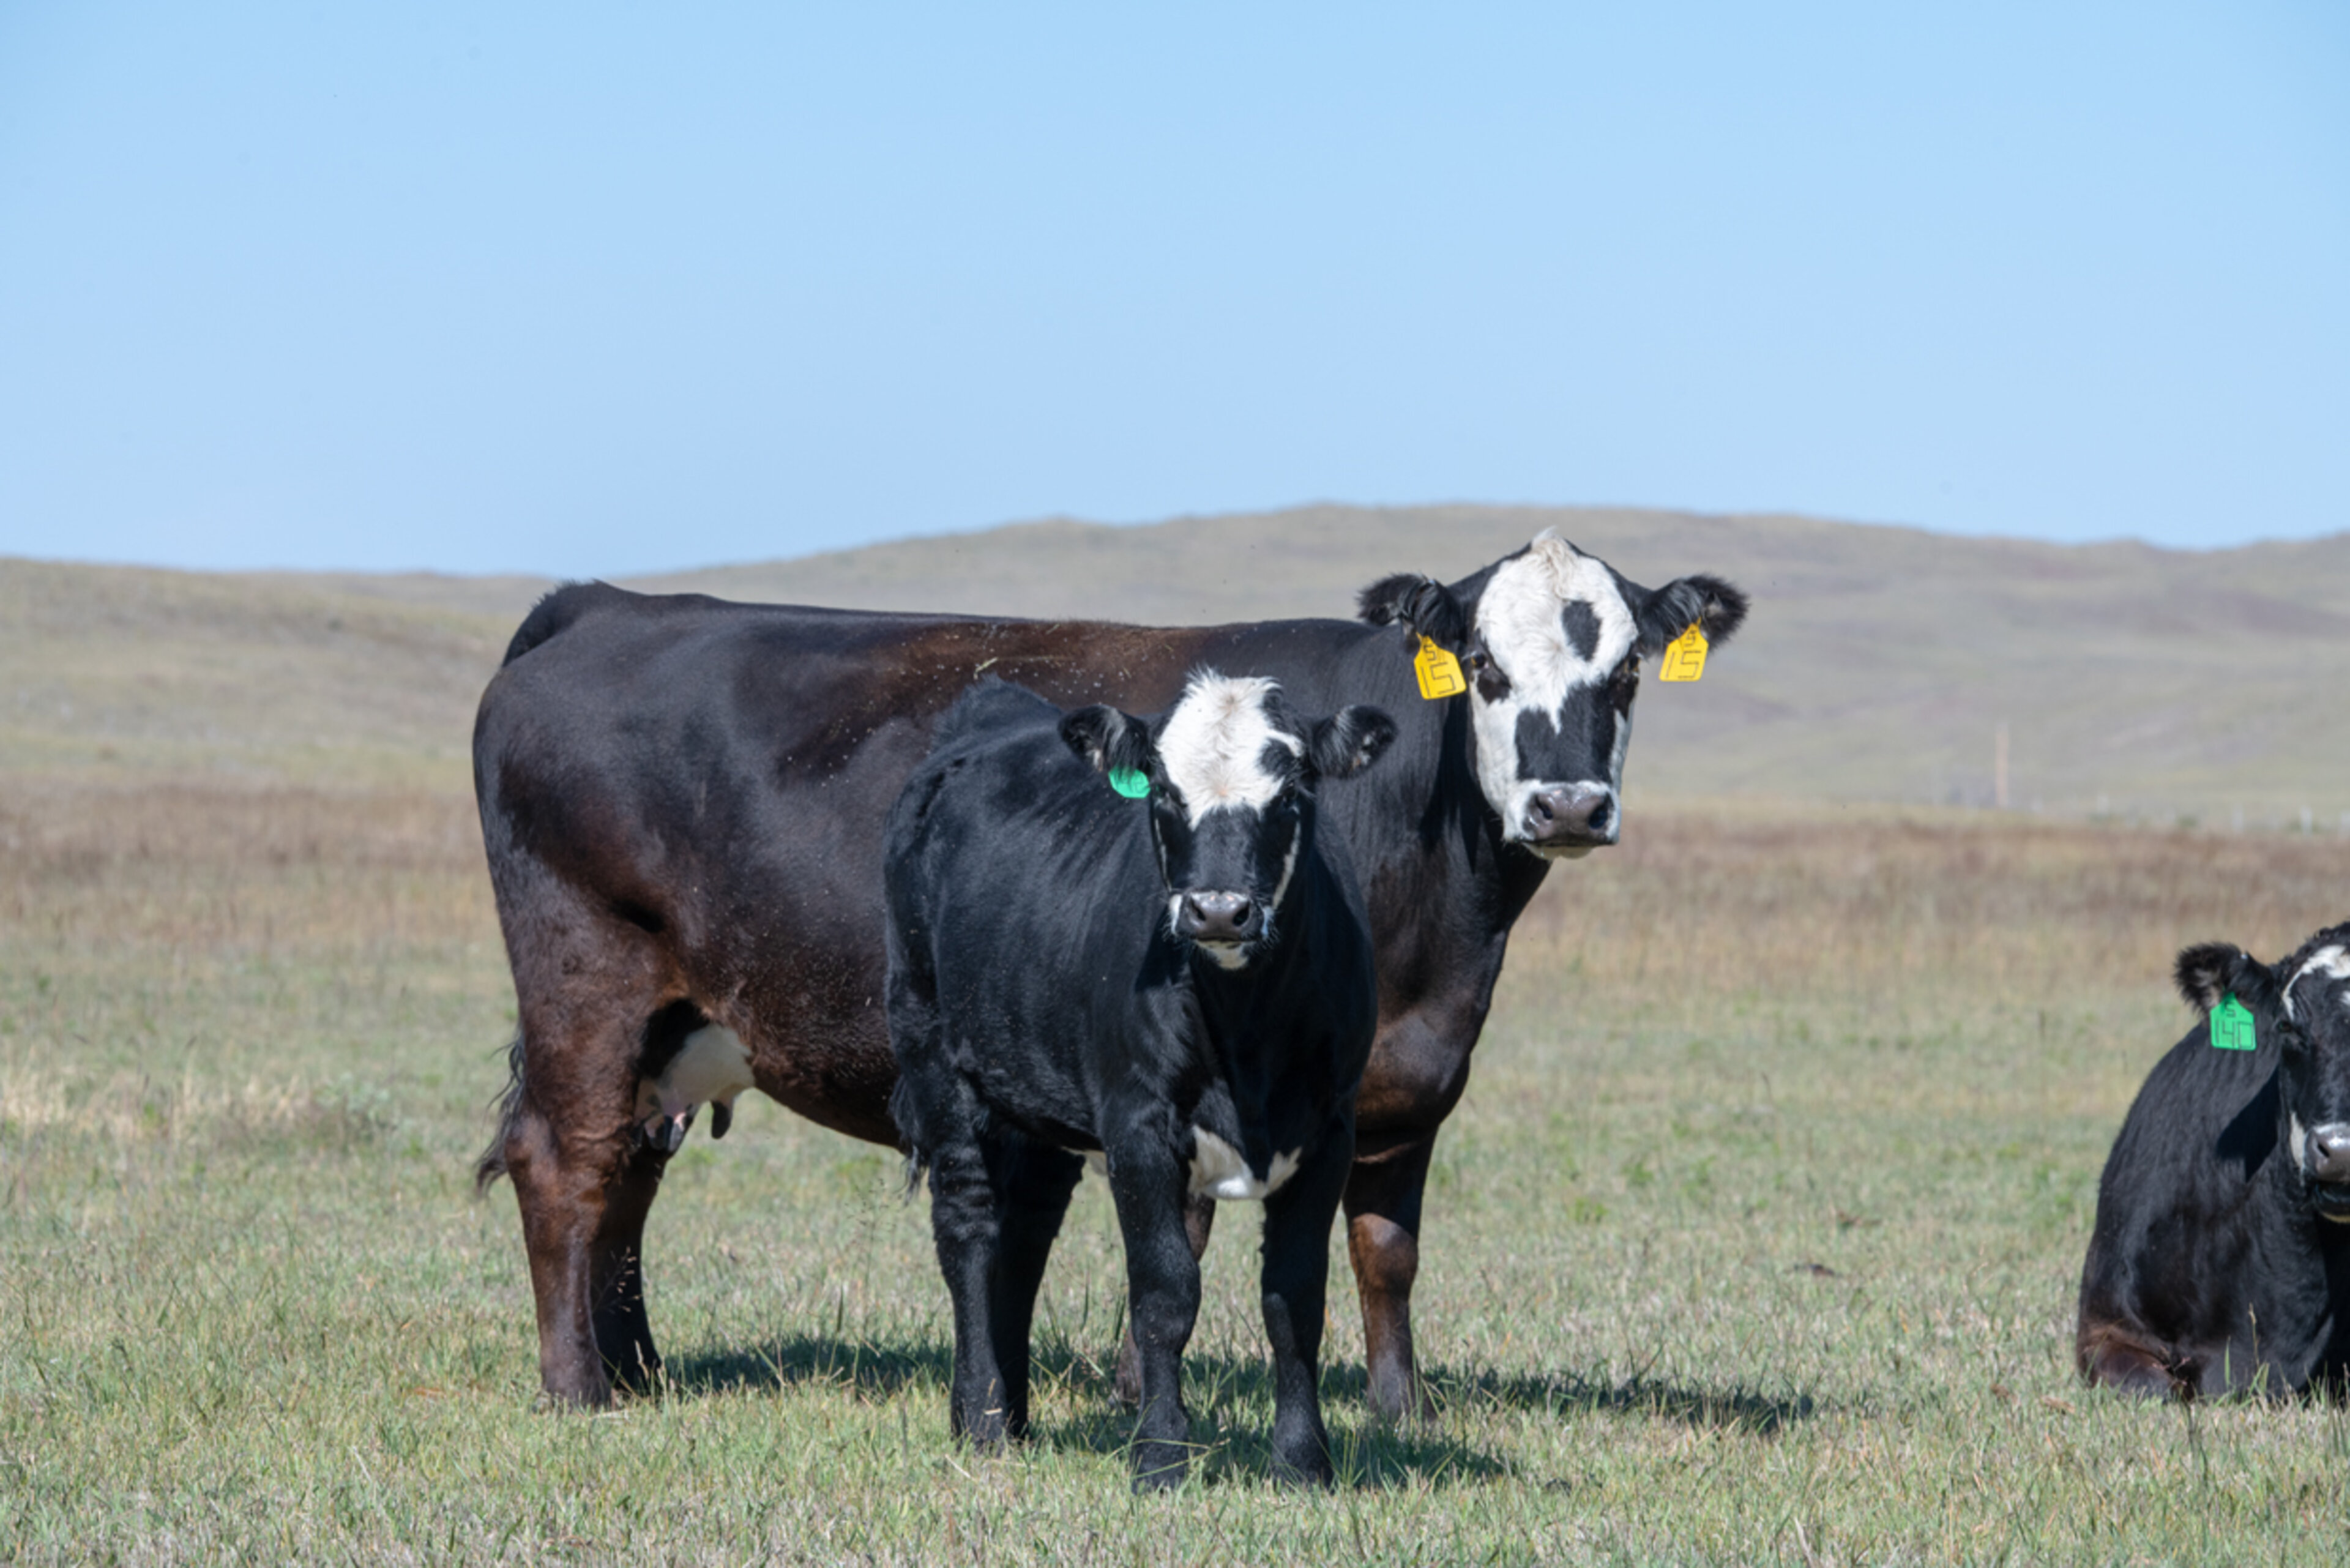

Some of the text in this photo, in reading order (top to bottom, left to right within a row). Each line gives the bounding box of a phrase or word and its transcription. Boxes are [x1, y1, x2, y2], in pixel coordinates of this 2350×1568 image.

[1420, 662, 1456, 697] 15
[1665, 651, 1701, 679] 15
[2215, 1020, 2256, 1049] 140
